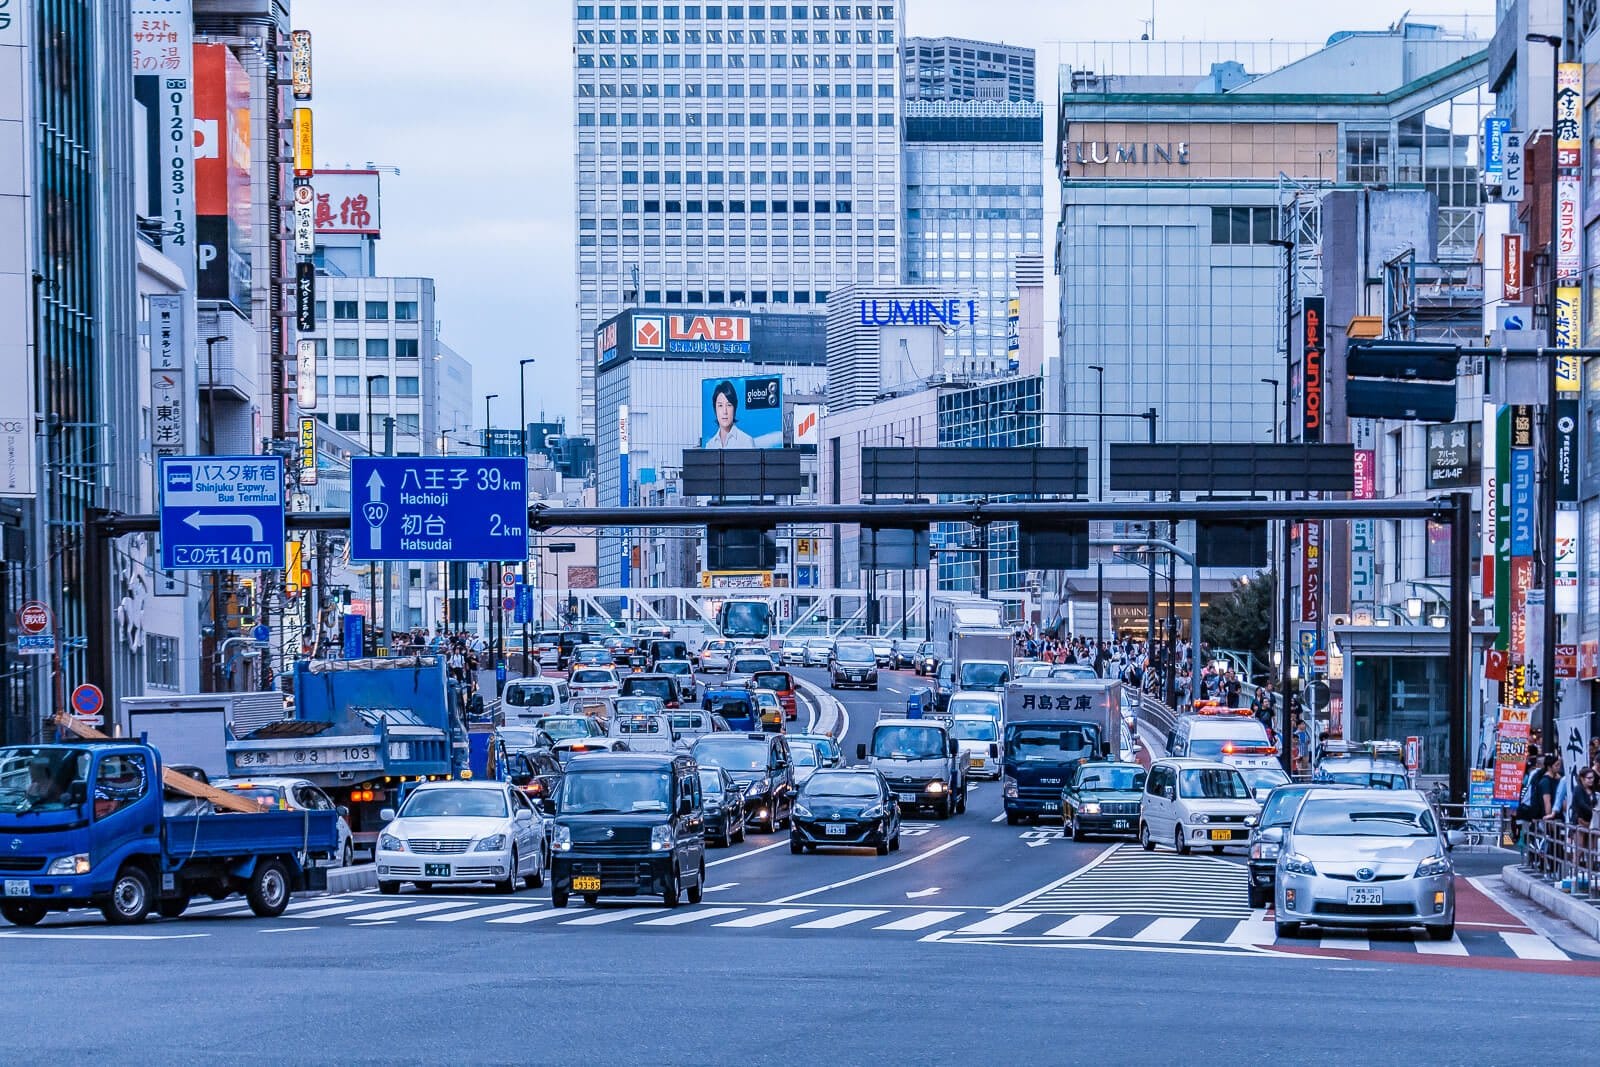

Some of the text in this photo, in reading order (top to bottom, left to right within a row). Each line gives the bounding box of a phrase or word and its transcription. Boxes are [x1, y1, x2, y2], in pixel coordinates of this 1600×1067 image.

[141, 20, 170, 30] ミスト
[133, 32, 178, 43] サウナ付
[1557, 88, 1580, 142] 金の蔵
[1076, 141, 1191, 165] LUMINE
[1558, 151, 1577, 163] 5F
[1560, 201, 1574, 253] カラオケ
[861, 299, 975, 326] LUMINE 1
[669, 316, 750, 341] LABI
[1306, 309, 1320, 429] disk union
[747, 388, 768, 404] global
[195, 465, 276, 481] バスタ新宿
[401, 468, 469, 490] 八王子
[1353, 452, 1367, 497] Serina
[195, 483, 268, 493] Shinjuku Expwy.
[218, 492, 277, 502] Bus Terminal
[400, 492, 449, 507] Hachioji
[368, 506, 383, 520] 20
[401, 514, 446, 536] 初台
[400, 538, 452, 551] Hatsudai
[176, 547, 271, 564] この先140m
[1113, 607, 1150, 617] LUMIN
[1021, 694, 1093, 711] 月島倉庫
[342, 748, 370, 760] 103
[1355, 894, 1381, 904] 29-20
